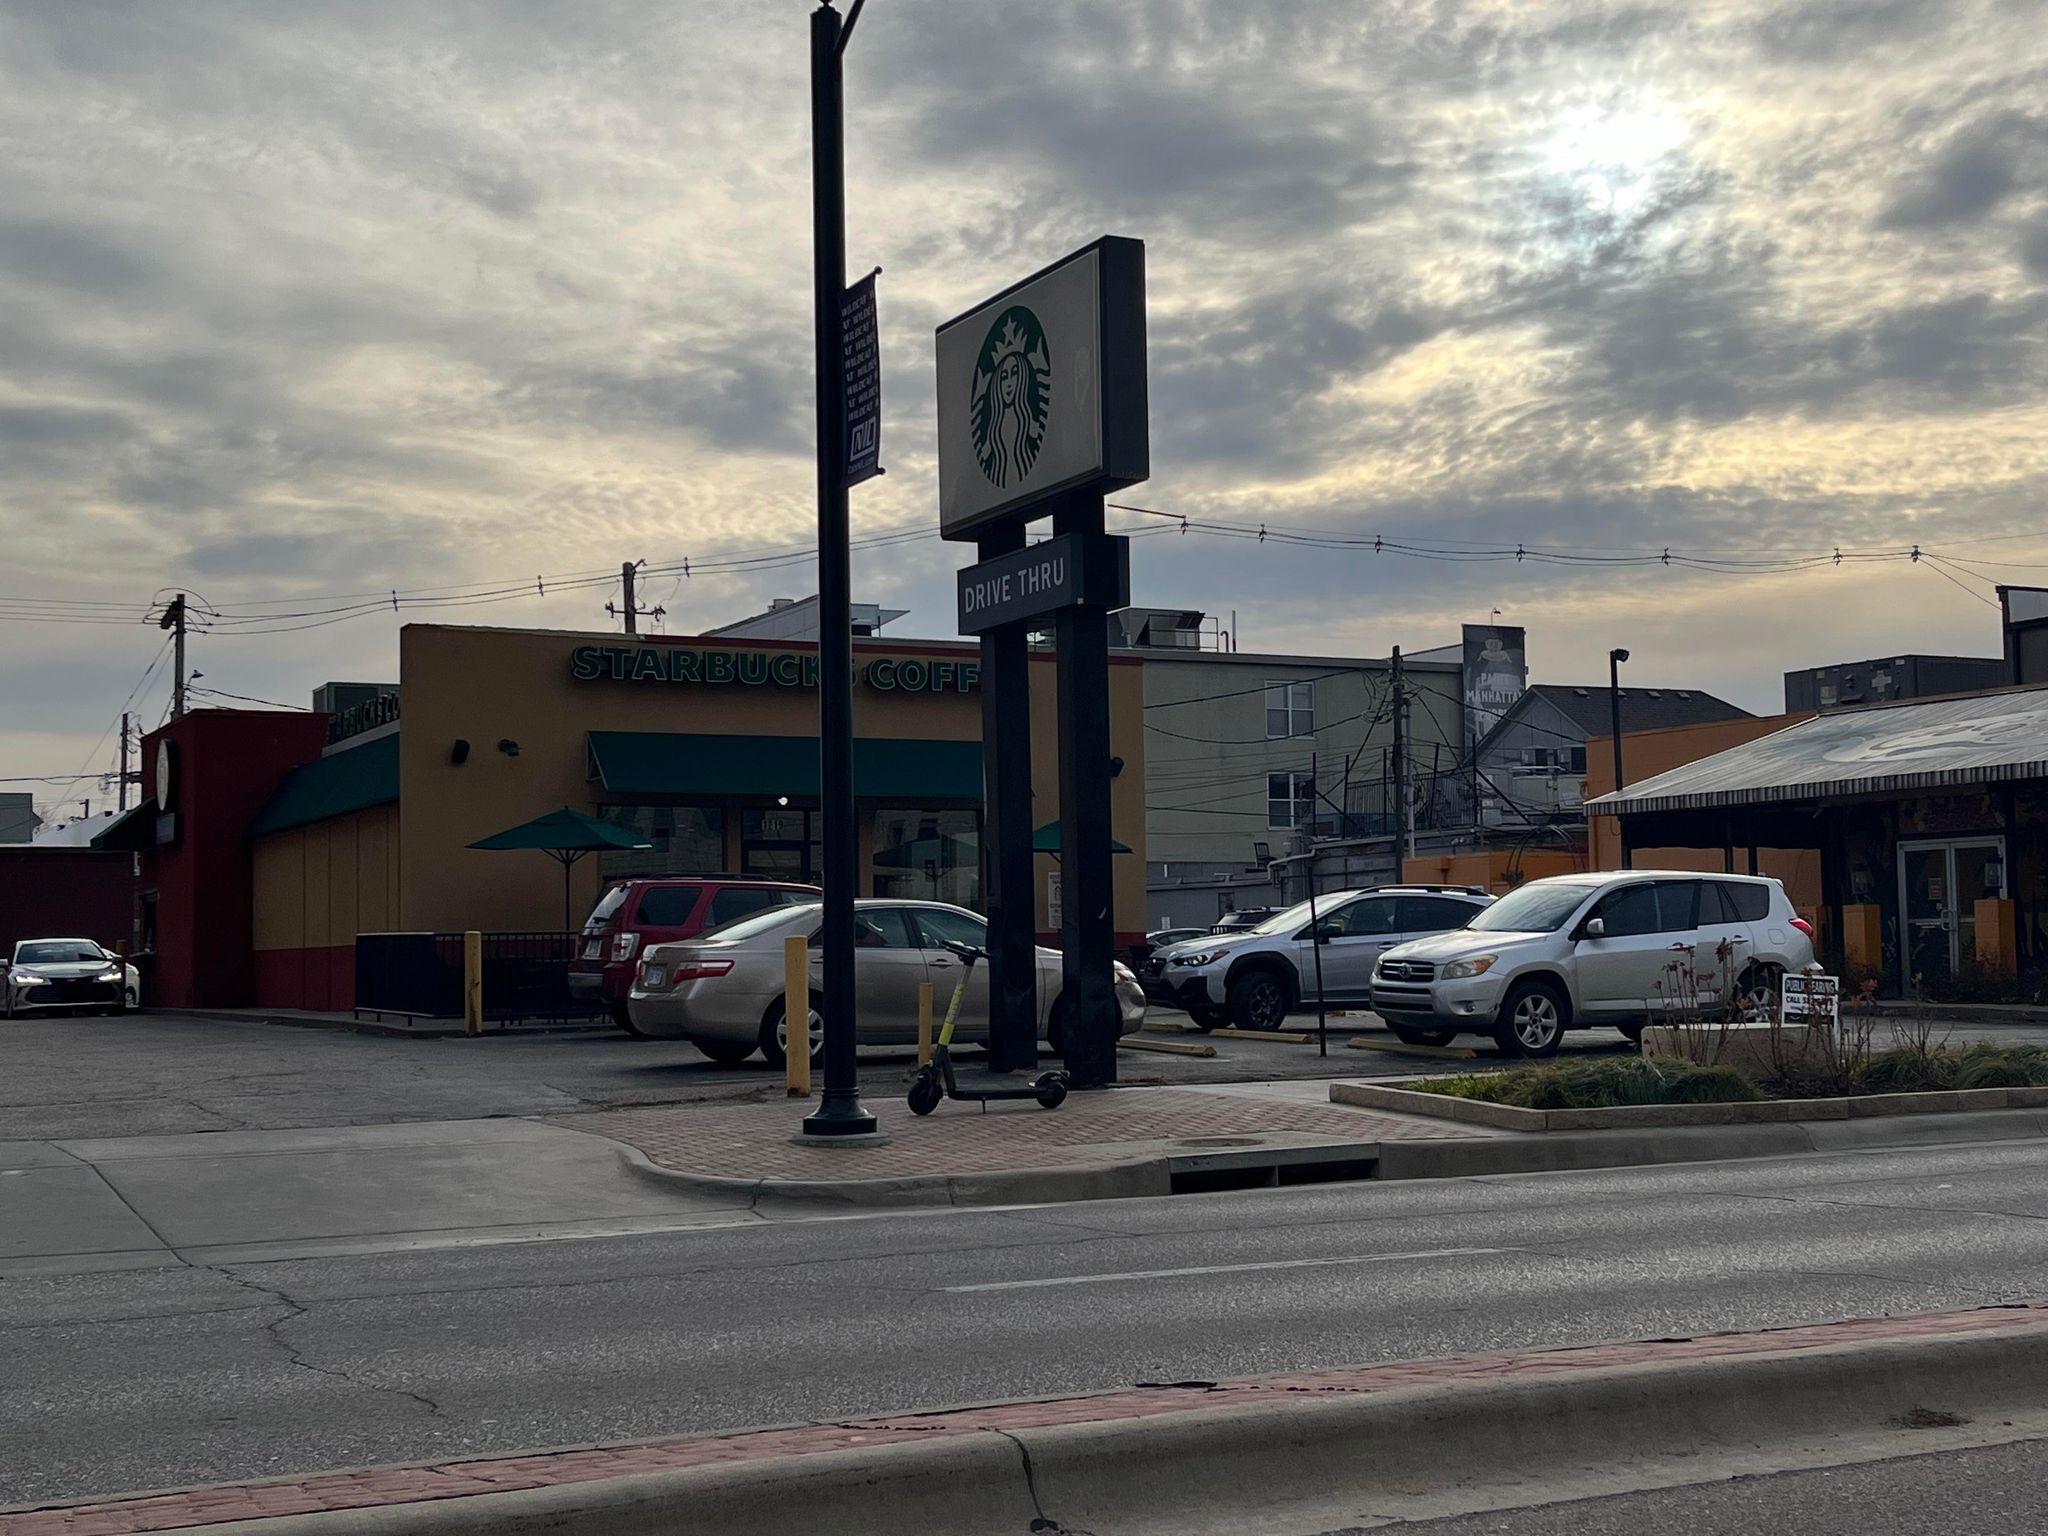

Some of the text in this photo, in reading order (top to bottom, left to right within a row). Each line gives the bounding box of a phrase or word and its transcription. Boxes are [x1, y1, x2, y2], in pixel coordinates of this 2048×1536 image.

[965, 557, 1063, 613] DRIVE THRU
[572, 647, 981, 692] STARBUCK COFF
[1786, 996, 1800, 1004] CALL
[1808, 980, 1834, 994] EARNG
